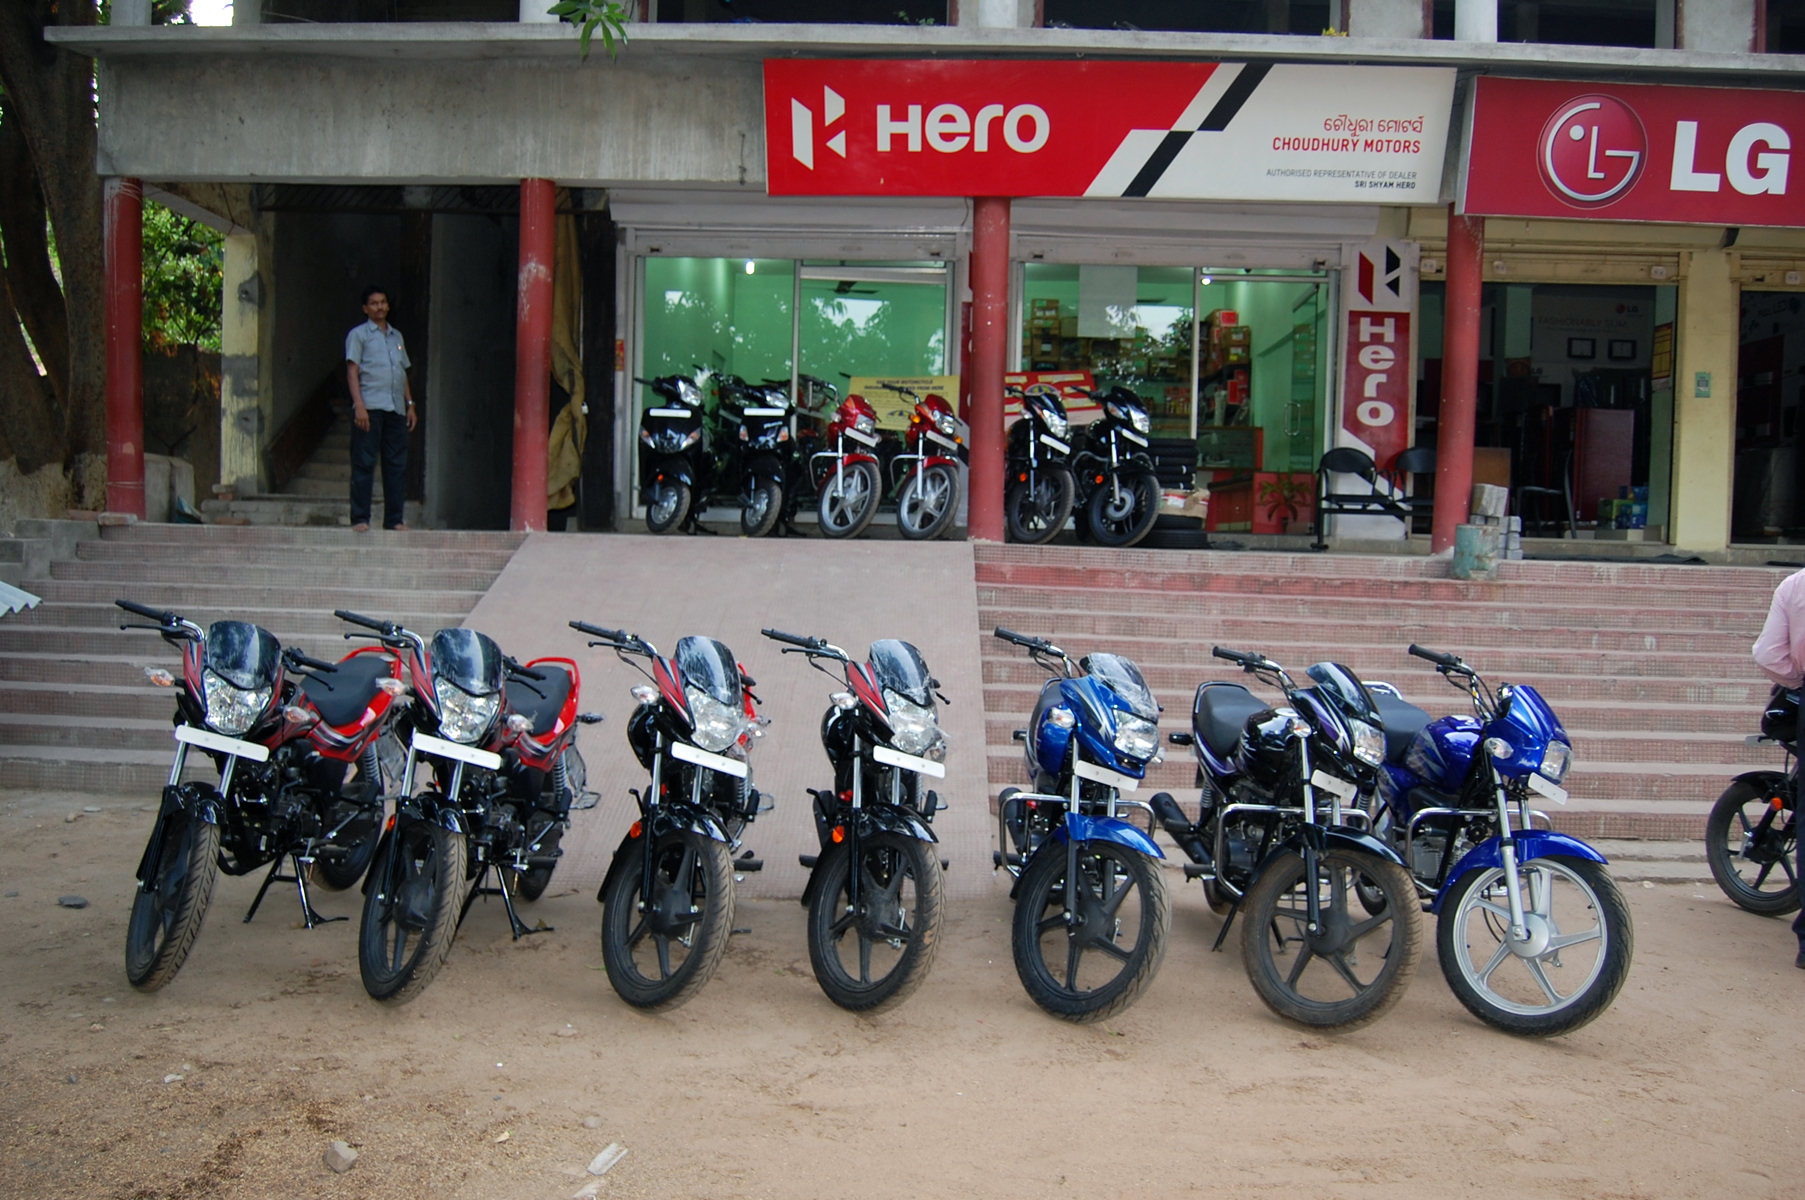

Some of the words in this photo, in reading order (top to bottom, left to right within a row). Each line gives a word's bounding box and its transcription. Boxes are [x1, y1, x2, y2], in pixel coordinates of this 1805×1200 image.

[877, 103, 1050, 153] Hero
[1272, 136, 1360, 153] CHOUDHURY
[1363, 138, 1421, 154] MOTORS
[1266, 168, 1312, 178] AUTHORISED
[1313, 169, 1376, 179] REPRESENTATIVE
[1377, 171, 1388, 179] OF
[1389, 171, 1418, 180] DEALER
[1670, 120, 1791, 196] LG
[1354, 180, 1367, 189] SRI
[1368, 180, 1394, 189] SHYAM
[1395, 181, 1416, 190] HERO
[1356, 317, 1396, 427] Hero
